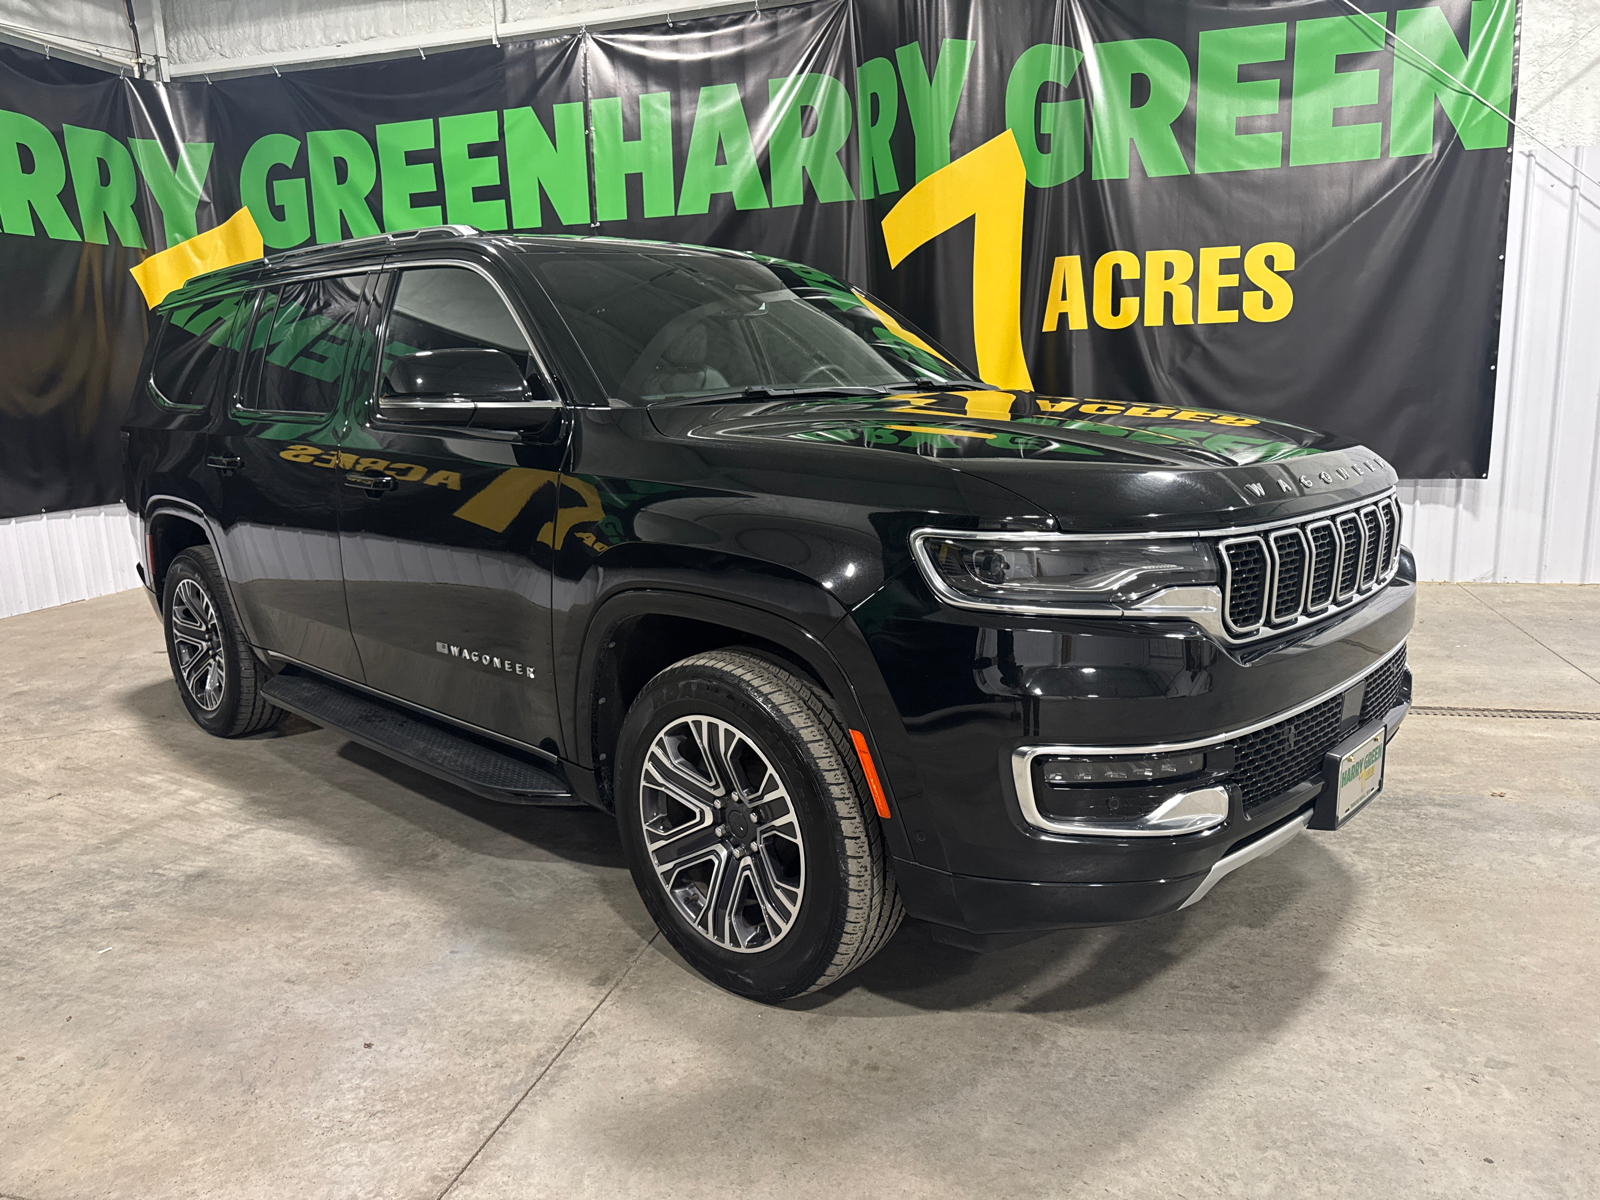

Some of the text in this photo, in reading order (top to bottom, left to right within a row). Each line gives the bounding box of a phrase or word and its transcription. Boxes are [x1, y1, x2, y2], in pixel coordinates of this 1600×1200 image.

[0, 105, 590, 250] RRY GREEN
[590, 0, 1516, 221] HARRY GREEN
[881, 128, 1296, 392] 7 ACRES
[450, 645, 536, 679] WAGONEER
[1341, 757, 1365, 789] HARRY
[1364, 742, 1383, 771] GREEN
